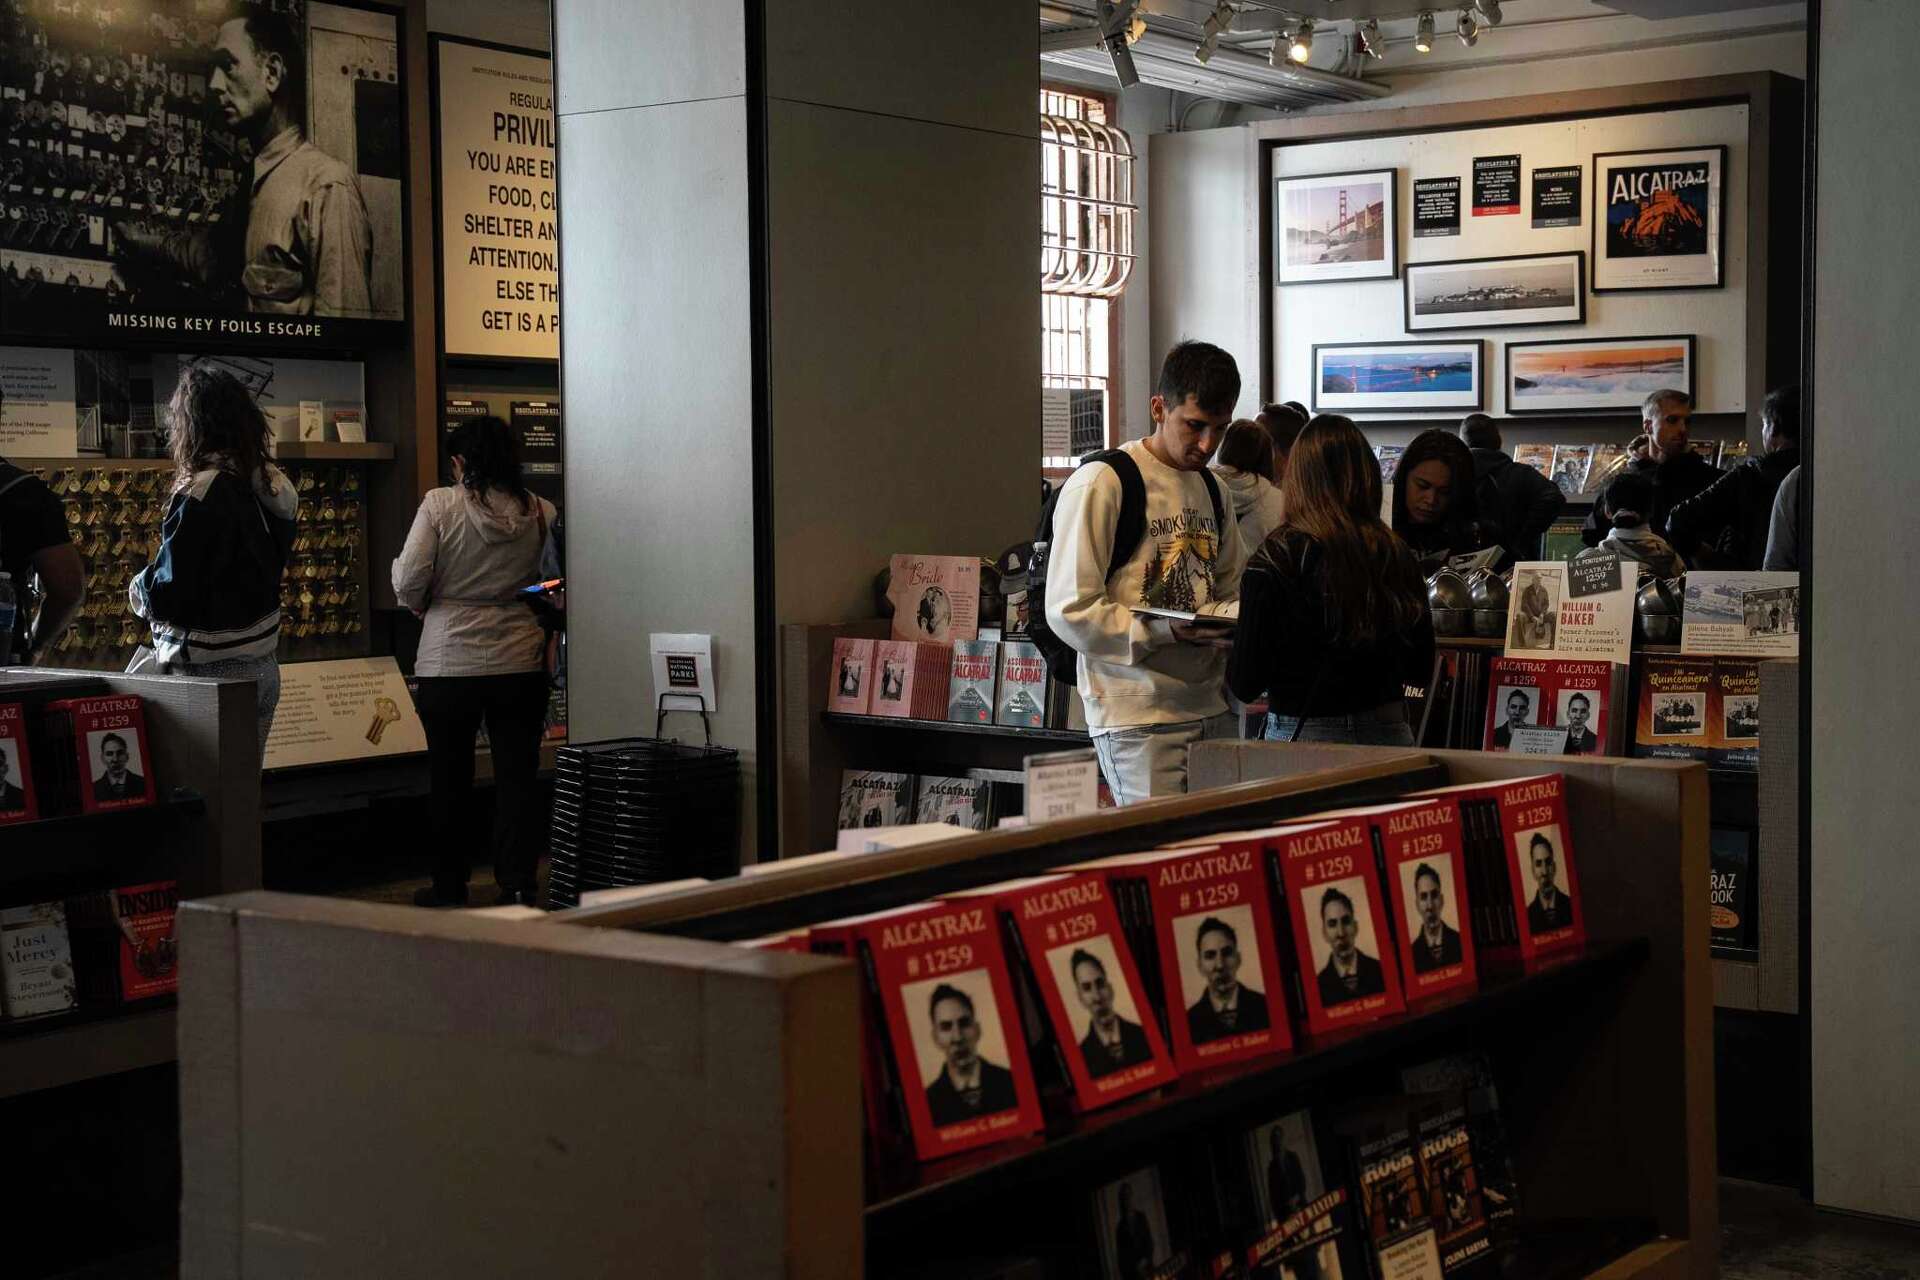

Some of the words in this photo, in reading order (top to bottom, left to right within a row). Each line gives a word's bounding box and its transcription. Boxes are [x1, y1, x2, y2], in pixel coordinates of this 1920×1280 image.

[493, 112, 554, 148] PRIVIL
[467, 150, 500, 171] YOU
[505, 155, 535, 177] ARE
[489, 185, 536, 211] FOOD,
[1611, 169, 1706, 205] ALCATRAZ
[464, 214, 533, 238] SHELTER
[469, 246, 557, 271] ATTENTION.
[497, 280, 534, 301] ELSE
[539, 283, 558, 302] TH
[108, 313, 177, 330] MISSING
[184, 318, 213, 332] KEY
[220, 320, 261, 335] FOILS
[268, 322, 321, 337] ESCAPE
[482, 310, 512, 330] GET
[518, 313, 531, 331] IS
[536, 315, 546, 332] A
[909, 562, 943, 585] Bride
[1574, 562, 1613, 576] ALCATRAZ
[1586, 571, 1606, 583] 1259
[1562, 602, 1593, 613] WILLIAM
[1561, 614, 1594, 626] BAKER
[671, 670, 695, 678] PARKS
[954, 664, 991, 680] ALCATRAZ
[1006, 667, 1042, 683] ALCATRAZ
[1496, 661, 1546, 672] ALCATRAZ
[1556, 664, 1608, 675] ALCATRAZ
[1514, 675, 1537, 686] 1259
[1564, 679, 1571, 687] #
[1574, 678, 1597, 688] 1259
[80, 699, 139, 714] ALCATRAZ
[92, 719, 98, 728] #
[103, 715, 129, 727] 1259
[851, 779, 900, 792] ALCATRAZ
[929, 785, 977, 797] ALCATRAZ
[1504, 781, 1559, 806] ALCATRAZ
[1389, 806, 1453, 835] ALCATRAZ
[1518, 813, 1524, 825] #
[1527, 805, 1553, 825] 1259
[1288, 826, 1363, 858] ALCATRAZ
[1402, 843, 1411, 855] #
[1413, 833, 1443, 854] 1259
[1159, 851, 1253, 887] ALCATRAZ
[1305, 864, 1314, 880] #
[1318, 855, 1353, 879] 1259
[1711, 873, 1736, 889] RAZ
[1023, 881, 1103, 919] ALCATRAZ
[1180, 892, 1190, 911] #
[1196, 882, 1239, 908] 1259
[1711, 889, 1733, 904] OOK
[882, 909, 987, 950] ALCATRAZ
[1046, 924, 1058, 942] #
[1060, 913, 1097, 940] 1259
[13, 934, 46, 949] Just
[8, 949, 56, 964] Mercy
[907, 956, 919, 976] #
[924, 944, 973, 973] 1259
[11, 988, 63, 1001] Stevenson
[21, 980, 51, 992] Bryan
[1420, 1124, 1470, 1159] ROCK
[1361, 1148, 1415, 1184] ROCK
